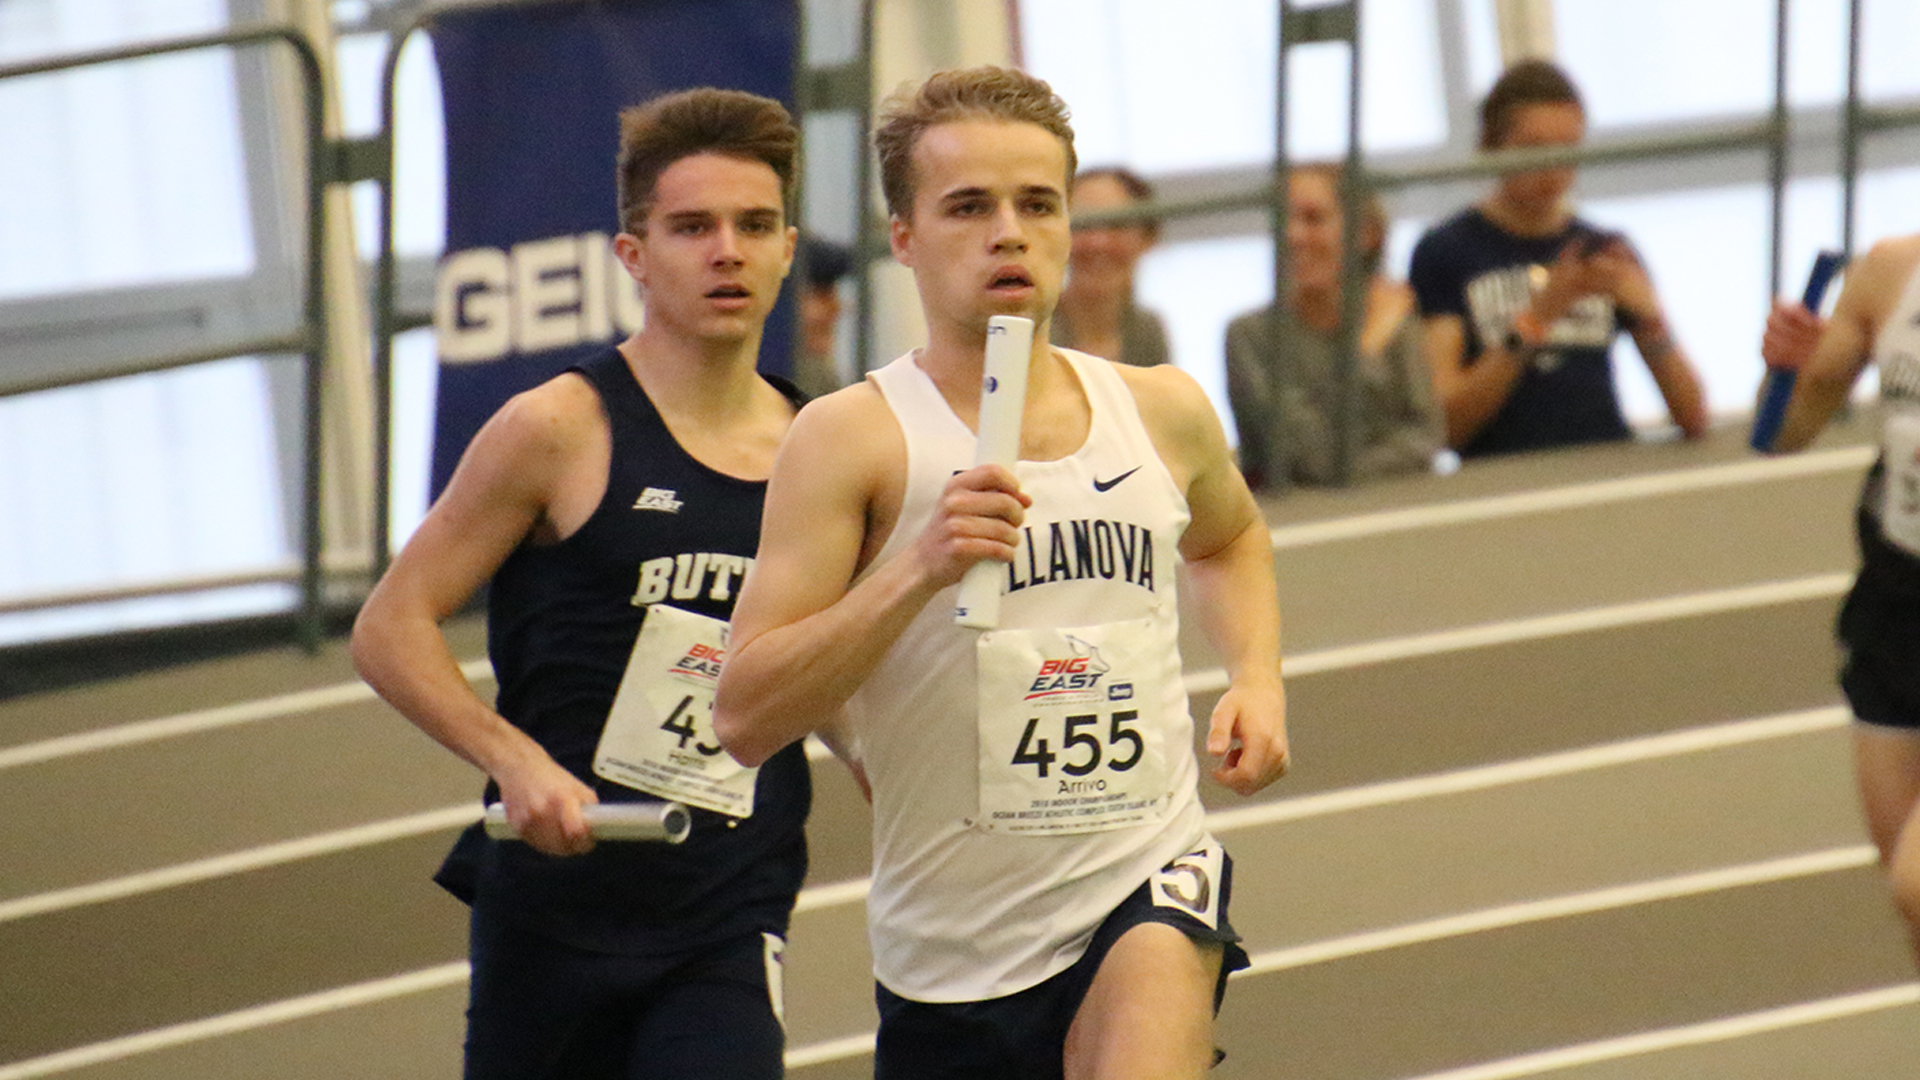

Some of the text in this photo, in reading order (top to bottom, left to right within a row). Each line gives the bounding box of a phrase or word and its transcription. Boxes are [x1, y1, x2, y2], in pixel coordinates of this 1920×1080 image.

[1038, 657, 1090, 676] BIG
[1029, 672, 1104, 692] EAST
[1010, 709, 1145, 778] 455
[1057, 778, 1107, 795] Arrivo
[1160, 848, 1211, 914] 5
